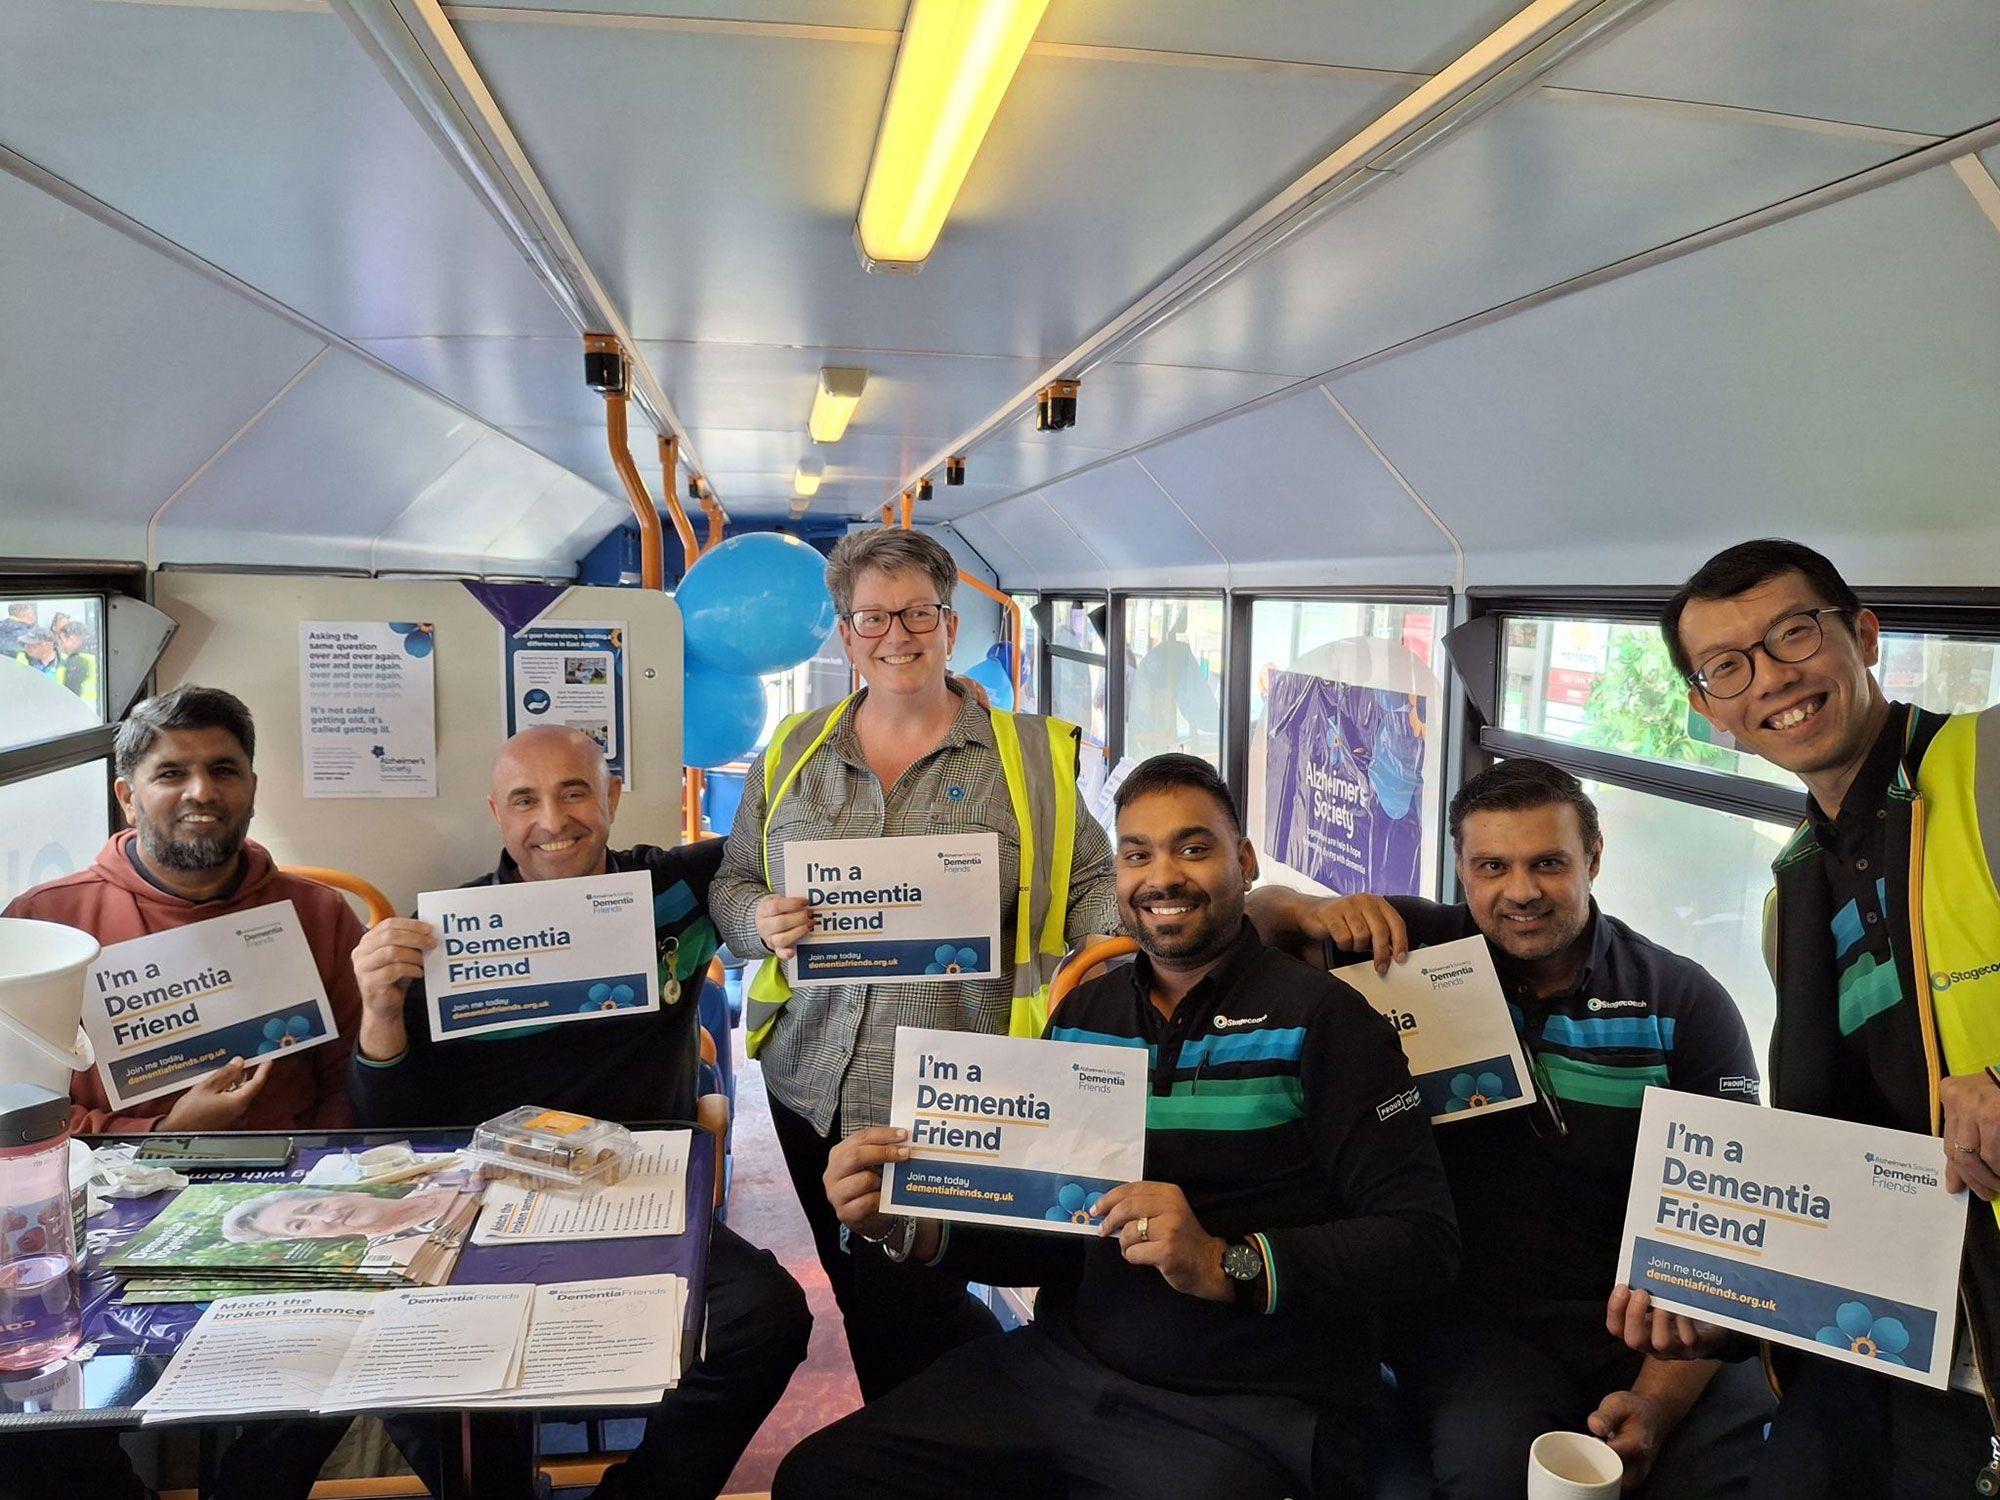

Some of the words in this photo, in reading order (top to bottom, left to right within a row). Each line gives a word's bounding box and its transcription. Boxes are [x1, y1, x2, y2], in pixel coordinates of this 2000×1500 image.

[309, 632, 341, 641] Asking
[545, 632, 578, 641] fundraising
[585, 633, 606, 641] making
[336, 643, 378, 651] question
[527, 642, 559, 650] difference
[332, 652, 350, 660] and
[375, 653, 402, 661] again.
[352, 662, 373, 670] over
[375, 662, 402, 670] again.
[311, 717, 346, 725] getting
[343, 727, 379, 735] getting
[1306, 761, 1369, 807] Alzheimer's
[1350, 845, 1361, 858] hope
[944, 857, 981, 866] Dementia
[1346, 858, 1366, 874] dementia
[807, 863, 840, 882] I'm
[849, 866, 862, 880] a
[593, 898, 633, 907] Dementia
[808, 883, 922, 906] Dementia
[443, 913, 480, 934] I'm
[489, 914, 503, 928] a
[810, 911, 883, 932] Friend
[445, 927, 571, 956] Dementia
[808, 953, 825, 961] Join
[840, 952, 861, 961] today
[808, 958, 898, 970] dementiafriends.org.uk
[96, 969, 138, 992] I'm
[145, 963, 160, 979] a
[449, 957, 530, 982] Friend
[1430, 967, 1473, 982] Dementia
[1950, 961, 2000, 983] Stageco
[1432, 977, 1464, 990] Friends
[104, 968, 232, 1018] Dementia
[452, 1003, 469, 1012] Join
[485, 998, 509, 1007] today
[1601, 1000, 1647, 1008] Stagecoach
[113, 1003, 200, 1045] Friend
[125, 1066, 144, 1077] Join
[145, 1061, 158, 1069] me
[160, 1053, 184, 1067] today
[128, 1048, 226, 1086] dementiafriends.org.uk
[919, 1055, 958, 1080] I'm
[966, 1064, 981, 1082] a
[1079, 1073, 1125, 1086] Dementia
[1723, 1080, 1743, 1088] PROUD
[1079, 1082, 1111, 1094] Friends
[917, 1085, 1050, 1120] Dementia
[1381, 1099, 1401, 1116] PROUD
[912, 1119, 1002, 1150] Friend
[1666, 1122, 1714, 1157] I'm
[1724, 1141, 1743, 1163] a
[1876, 1156, 1912, 1169] Alzheimer's
[240, 1170, 285, 1180] with
[907, 1172, 926, 1182] Join
[928, 1174, 942, 1183] me
[943, 1174, 970, 1188] today
[1874, 1165, 1937, 1187] Dementia
[906, 1183, 1014, 1201] dementiafriends.org.uk
[1662, 1157, 1830, 1220] Dementia
[1873, 1176, 1917, 1195] Friends
[1657, 1196, 1766, 1248] Friend
[127, 1222, 187, 1259] Dementia
[1648, 1256, 1670, 1270] Join
[1673, 1263, 1689, 1275] me
[1692, 1264, 1723, 1285] today
[557, 1288, 667, 1300] DementiaFriends
[1646, 1268, 1777, 1311] dementiafriends.org.uk
[220, 1300, 276, 1311] Match
[283, 1298, 312, 1306] the
[408, 1292, 520, 1305] DementiaFriends
[213, 1309, 277, 1320] broken
[282, 1307, 376, 1316] sentences
